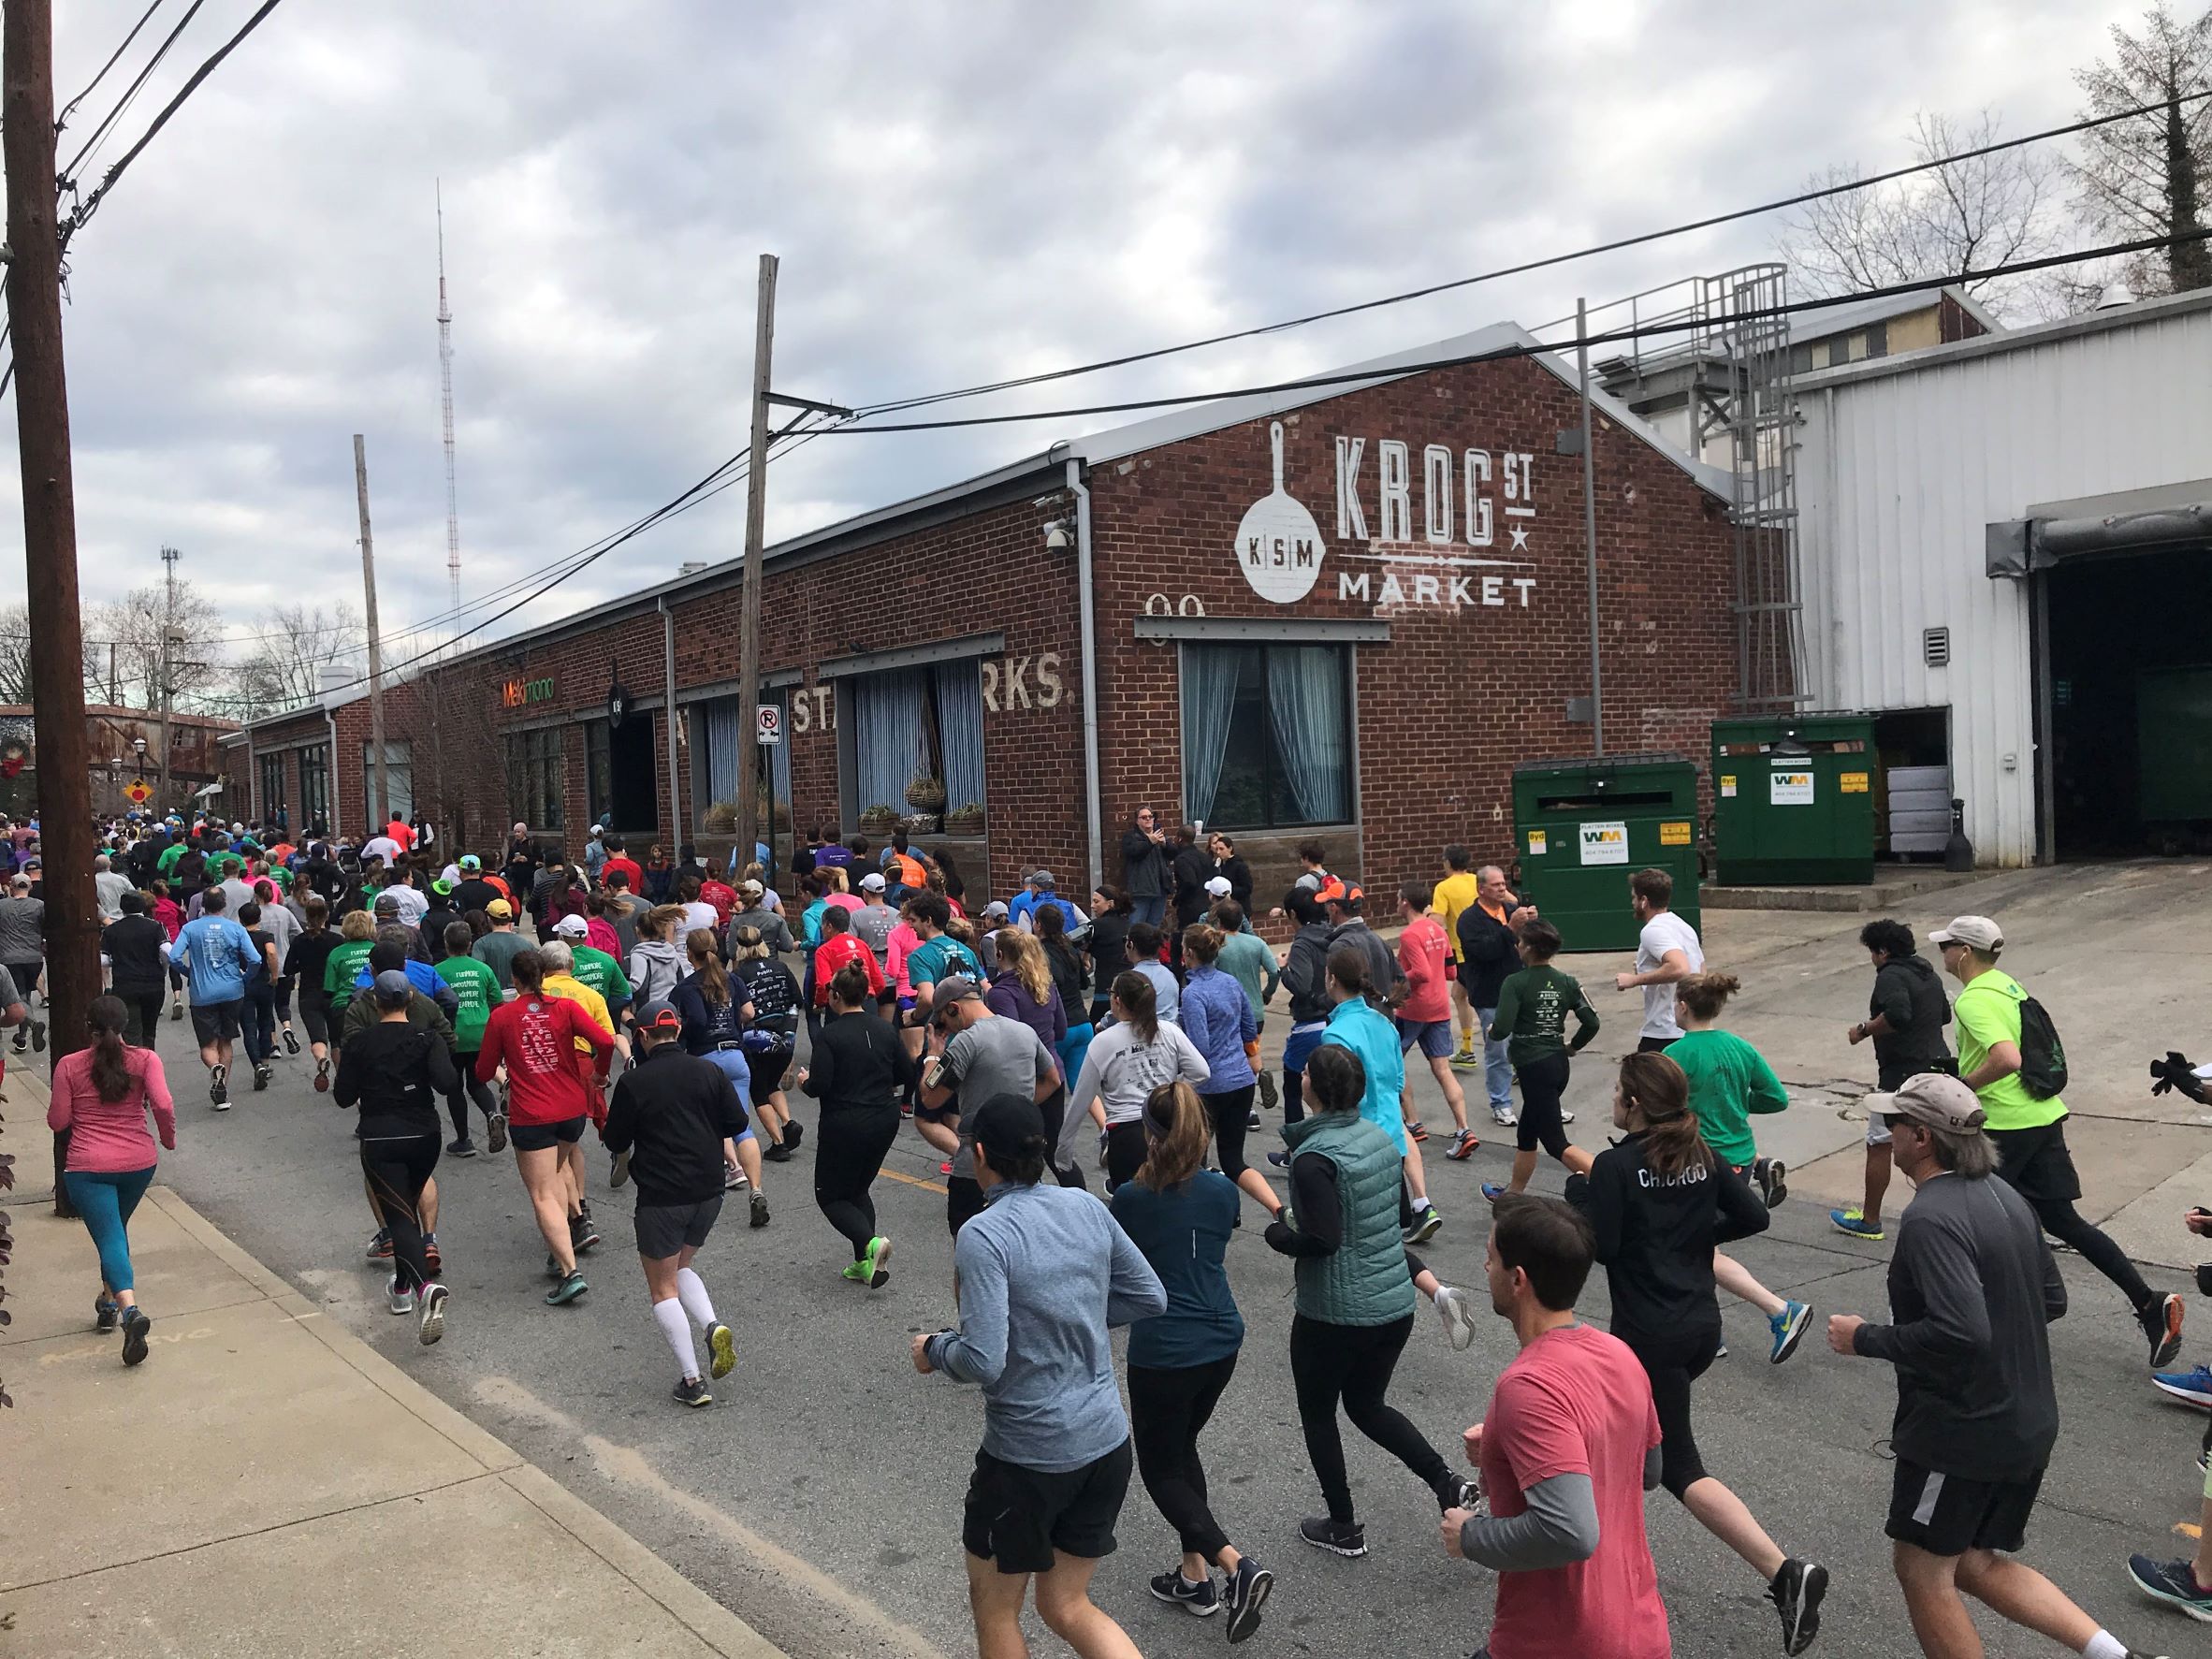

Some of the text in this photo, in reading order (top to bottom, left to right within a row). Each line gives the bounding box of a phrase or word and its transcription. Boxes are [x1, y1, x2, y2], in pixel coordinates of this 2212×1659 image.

[1335, 436, 1535, 546] KROG ST
[1338, 572, 1537, 608] MARKET
[793, 686, 837, 733] ST
[1773, 775, 1809, 785] WM
[1583, 830, 1623, 843] WM
[1637, 1162, 1708, 1188] CHCAGO
